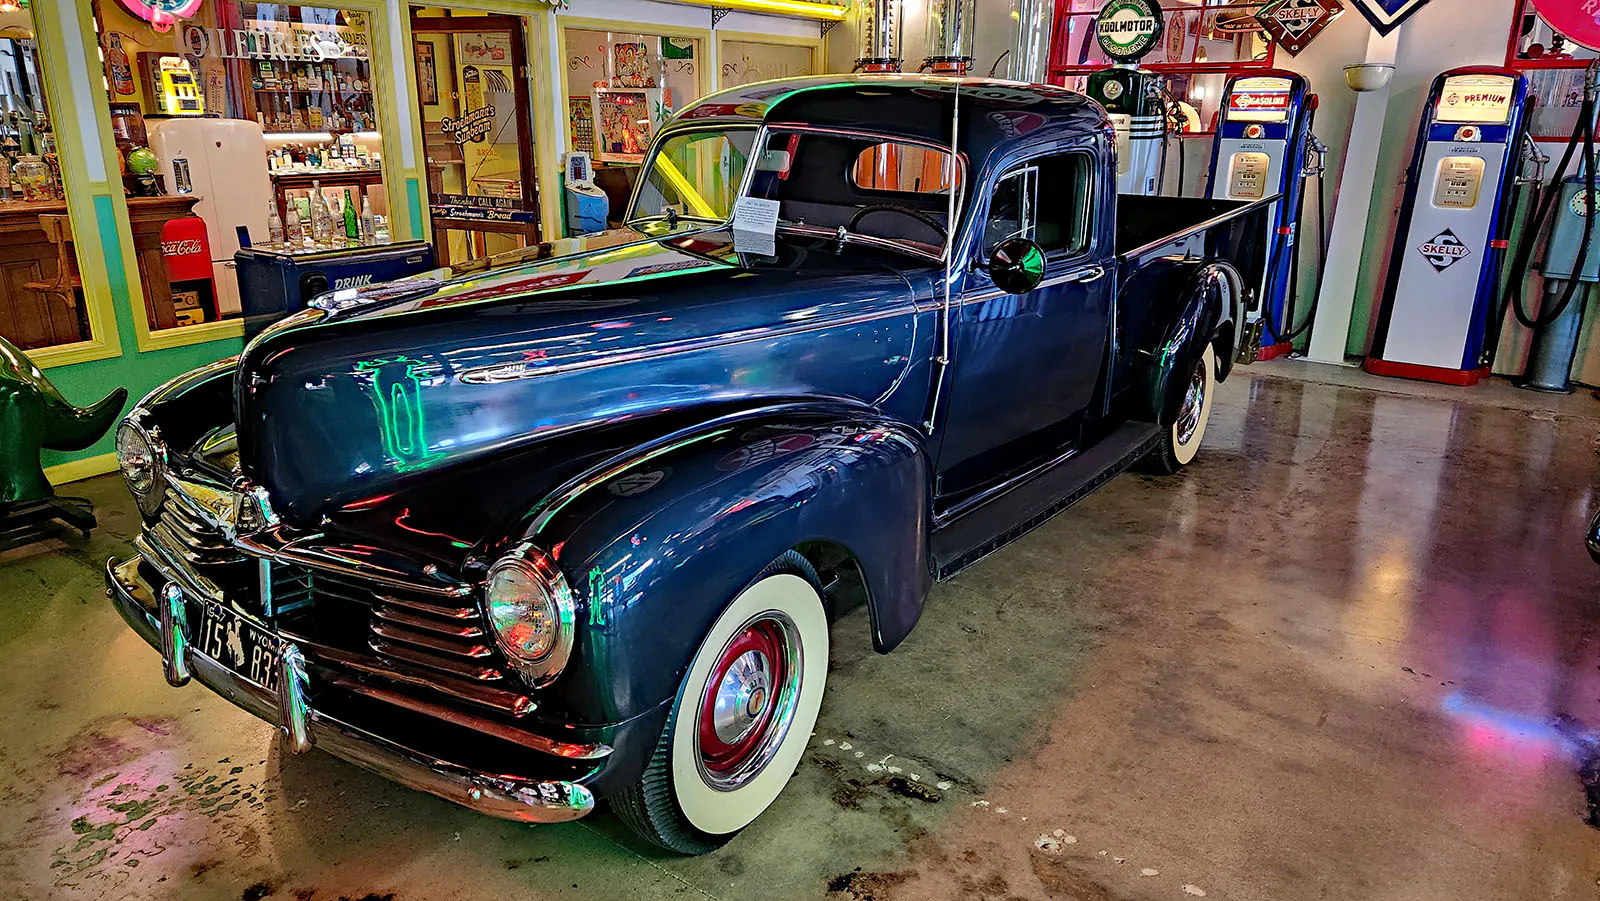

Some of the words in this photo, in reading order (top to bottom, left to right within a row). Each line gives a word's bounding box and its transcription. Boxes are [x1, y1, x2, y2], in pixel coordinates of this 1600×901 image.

[1278, 7, 1319, 19] SKELLY
[1099, 20, 1153, 33] KOOLMOTOR
[1102, 35, 1149, 55] GASOLENE
[1250, 96, 1286, 105] GASOLINE
[1464, 93, 1506, 104] PREMIUM
[441, 104, 496, 133] Stroehmann's
[455, 120, 492, 145] Sunbeam
[449, 195, 476, 206] Thanks!
[478, 197, 493, 207] CALL
[495, 198, 513, 208] AGAIN
[449, 208, 484, 218] Stroehmann's
[486, 209, 513, 220] Bread
[1423, 244, 1465, 255] SKELLY
[334, 274, 373, 290] DRINK
[206, 602, 226, 622] 197
[205, 618, 224, 660] 15
